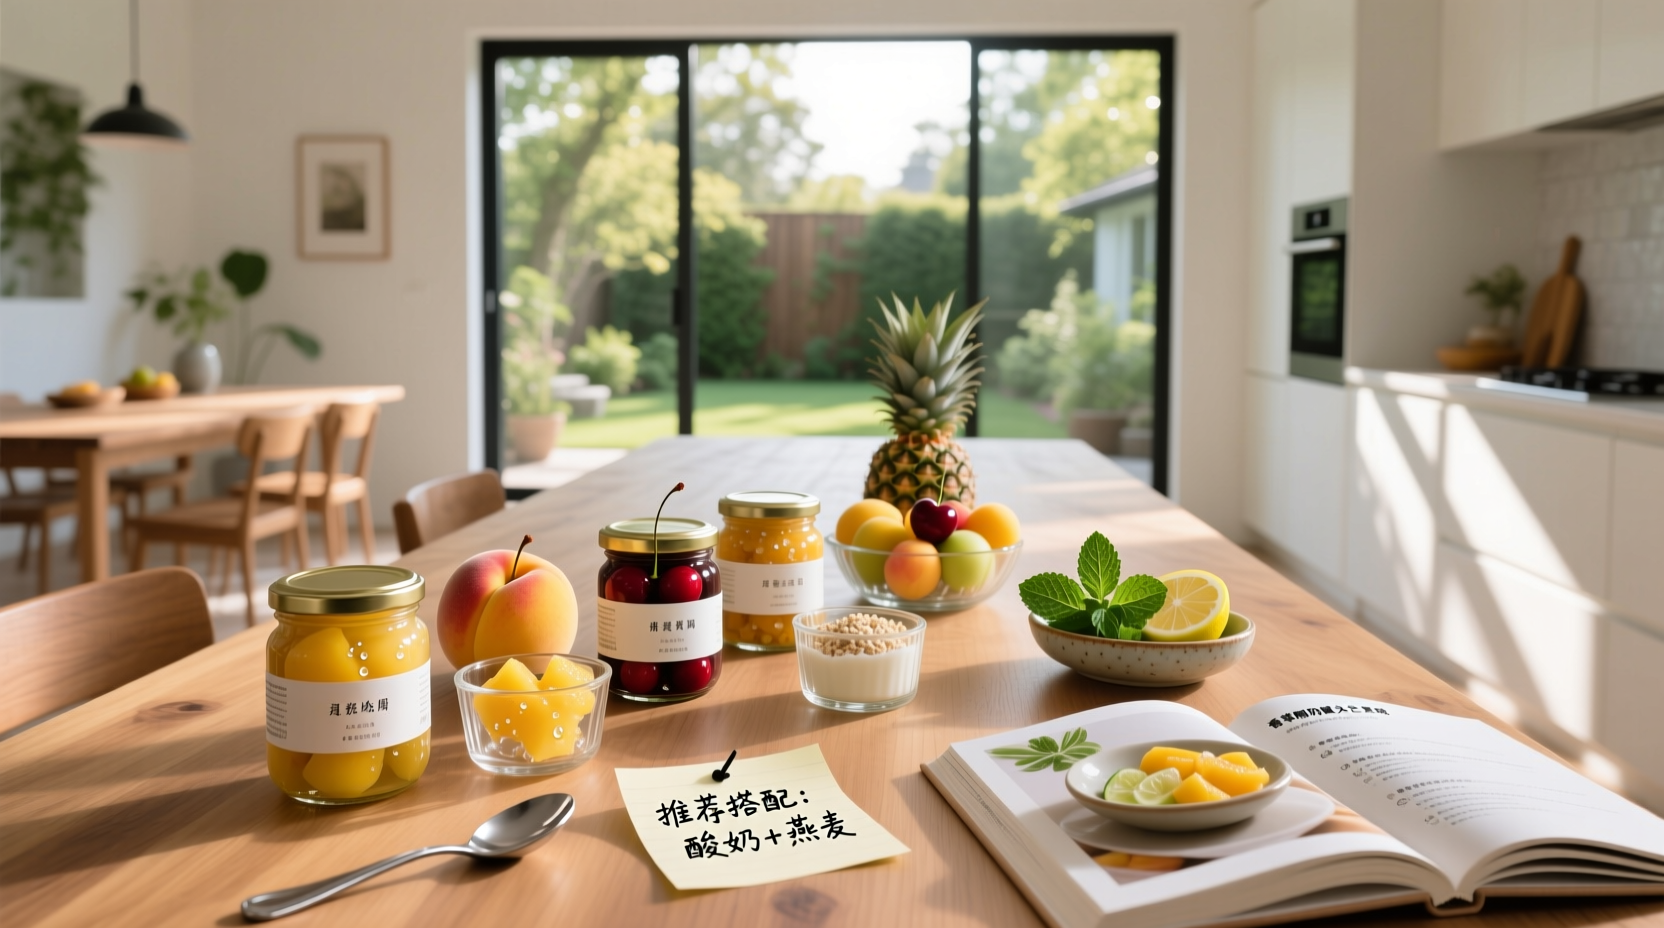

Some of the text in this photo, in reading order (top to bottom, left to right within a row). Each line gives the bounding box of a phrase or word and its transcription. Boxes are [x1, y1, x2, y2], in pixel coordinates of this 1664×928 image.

[655, 789, 809, 828] 推荐搭配：
[684, 810, 857, 859] 酸奶+燕麦
